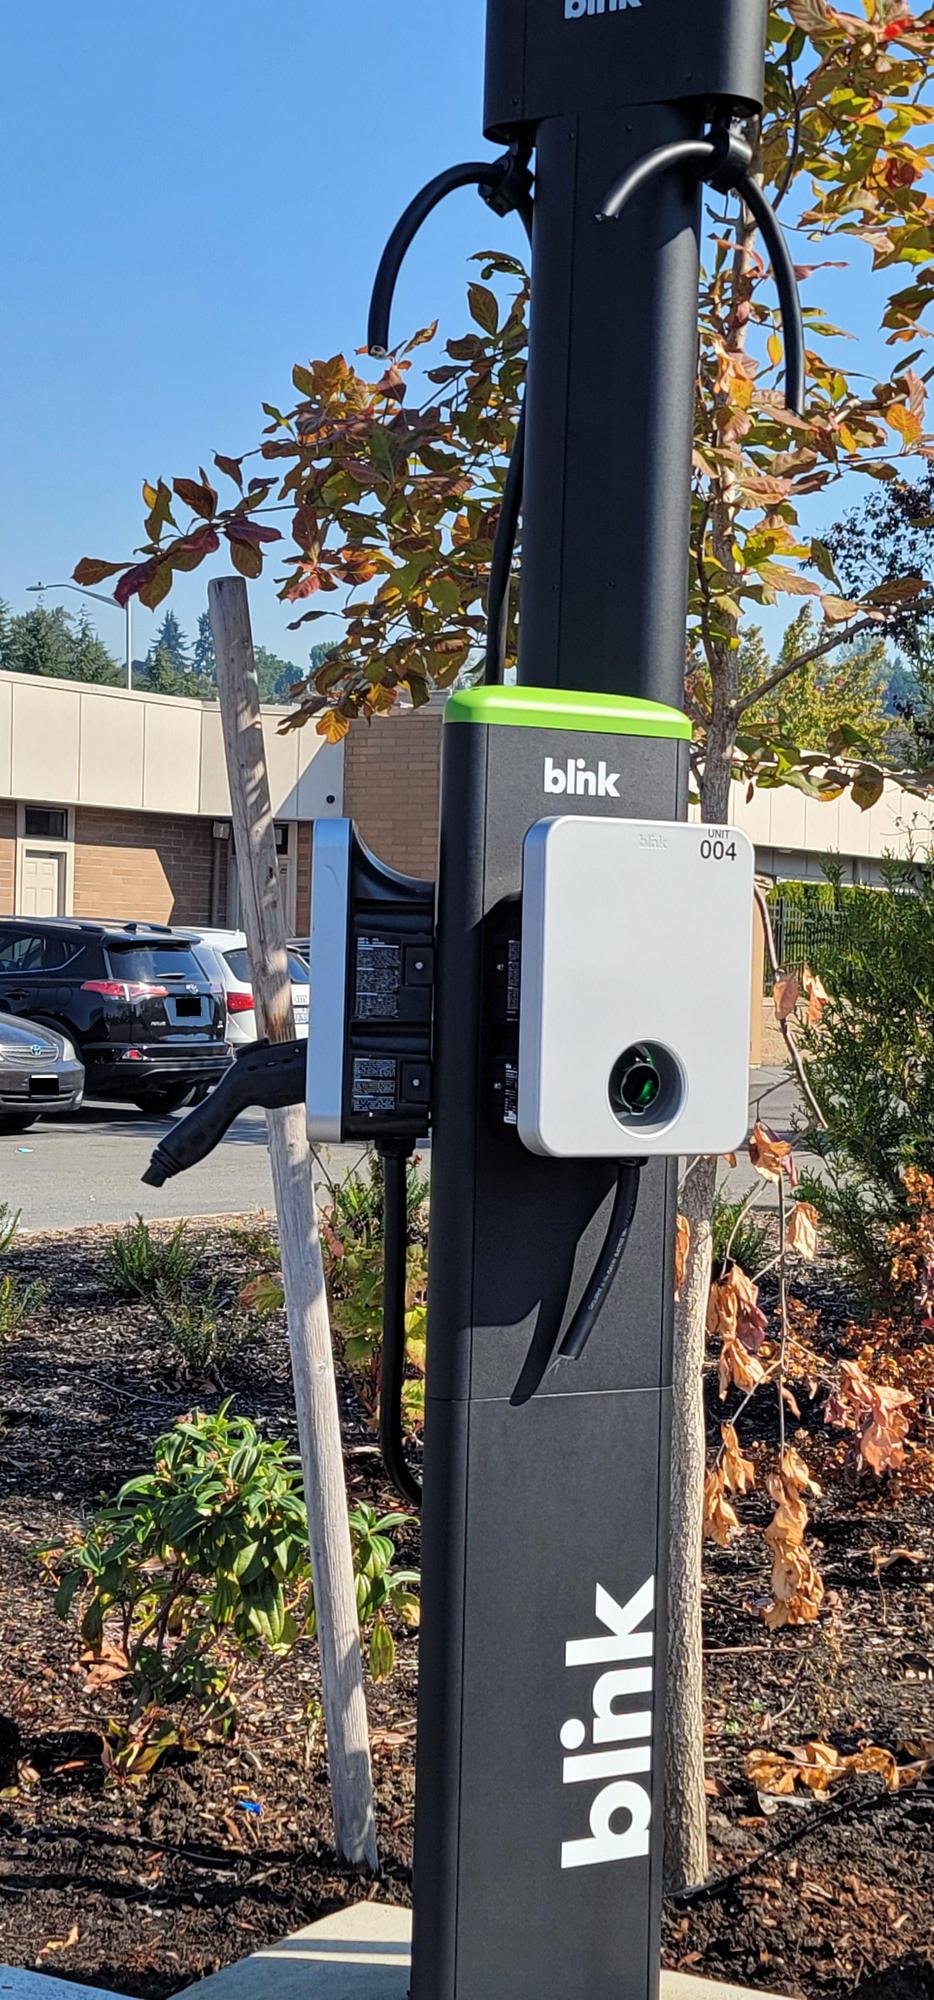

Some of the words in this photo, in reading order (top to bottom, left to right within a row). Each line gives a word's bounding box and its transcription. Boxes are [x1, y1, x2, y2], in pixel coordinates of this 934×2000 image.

[544, 757, 621, 797] blink
[639, 833, 668, 849] blink
[708, 829, 730, 839] UNIT
[700, 840, 737, 861] 004
[560, 1575, 655, 1869] blink
